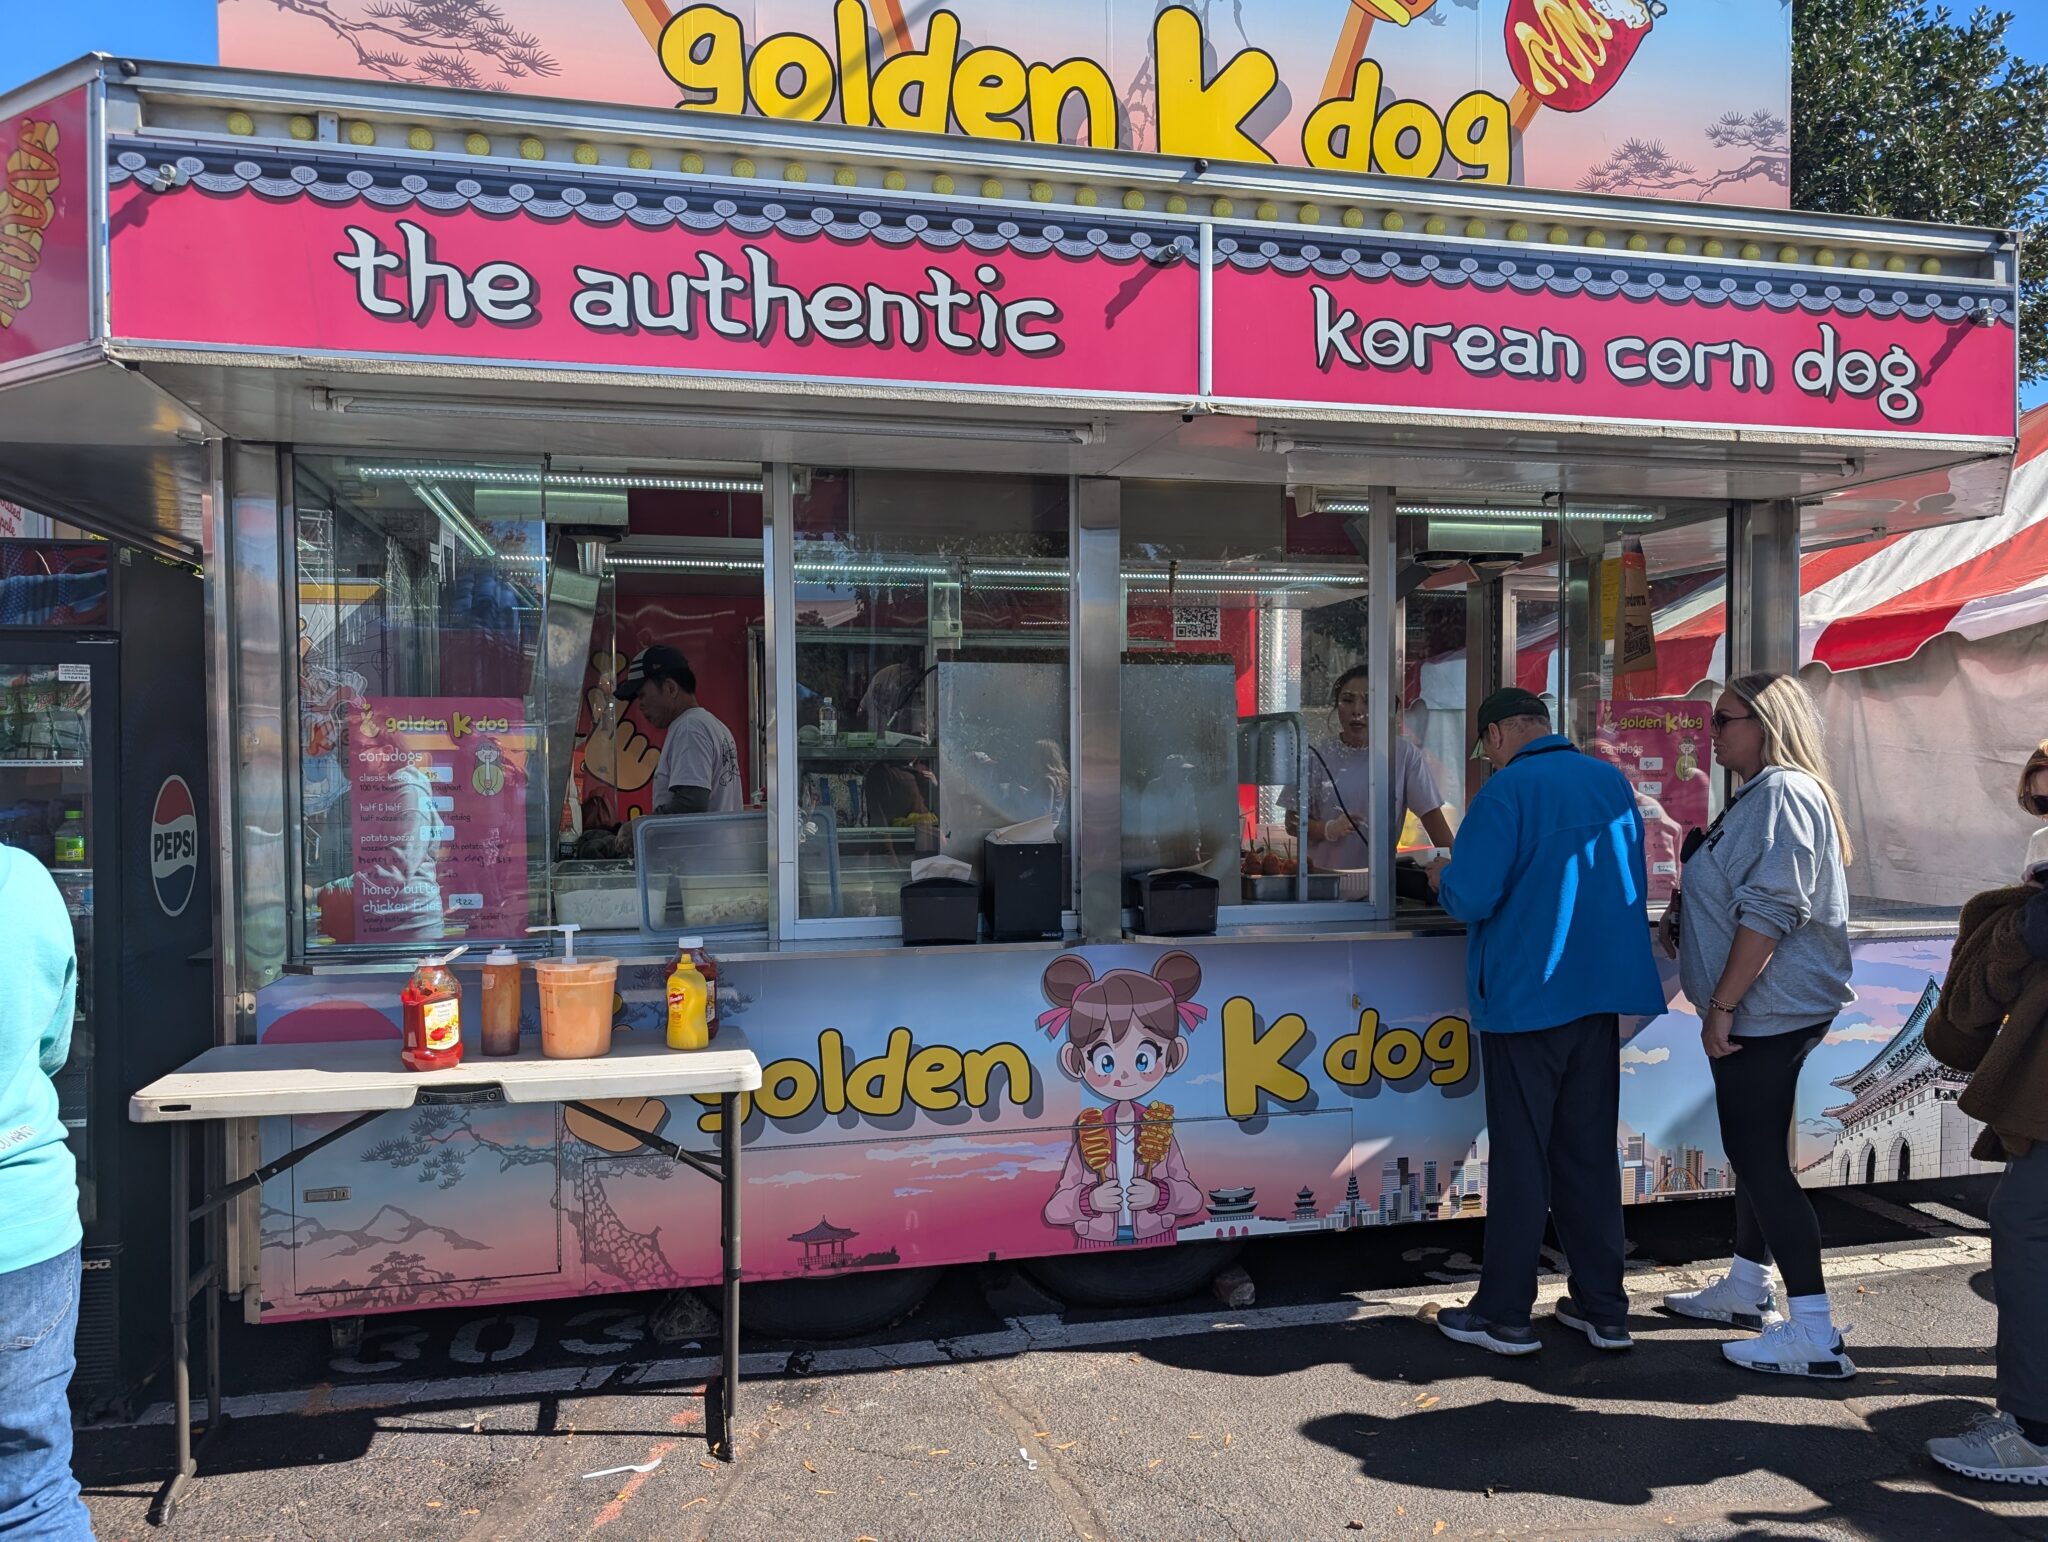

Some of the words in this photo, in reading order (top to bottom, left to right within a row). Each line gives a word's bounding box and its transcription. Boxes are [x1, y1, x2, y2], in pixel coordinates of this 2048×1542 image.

[658, 0, 1119, 149] golden
[1301, 58, 1511, 186] dog
[334, 219, 533, 323] the
[571, 244, 1060, 352] authentic
[1310, 284, 1583, 378] korean
[1604, 335, 1769, 389] corn
[1792, 321, 1918, 420] dog
[385, 715, 448, 733] golden
[475, 715, 509, 733] dog
[1620, 715, 1662, 730] golden
[1680, 713, 1703, 730] dog
[1600, 741, 1645, 758] corndogs
[358, 751, 423, 767] corndogs
[153, 830, 196, 863] PEPSI
[360, 833, 388, 843] potato
[362, 883, 399, 899] honey
[362, 899, 409, 914] chicken
[1323, 1008, 1471, 1087] dog
